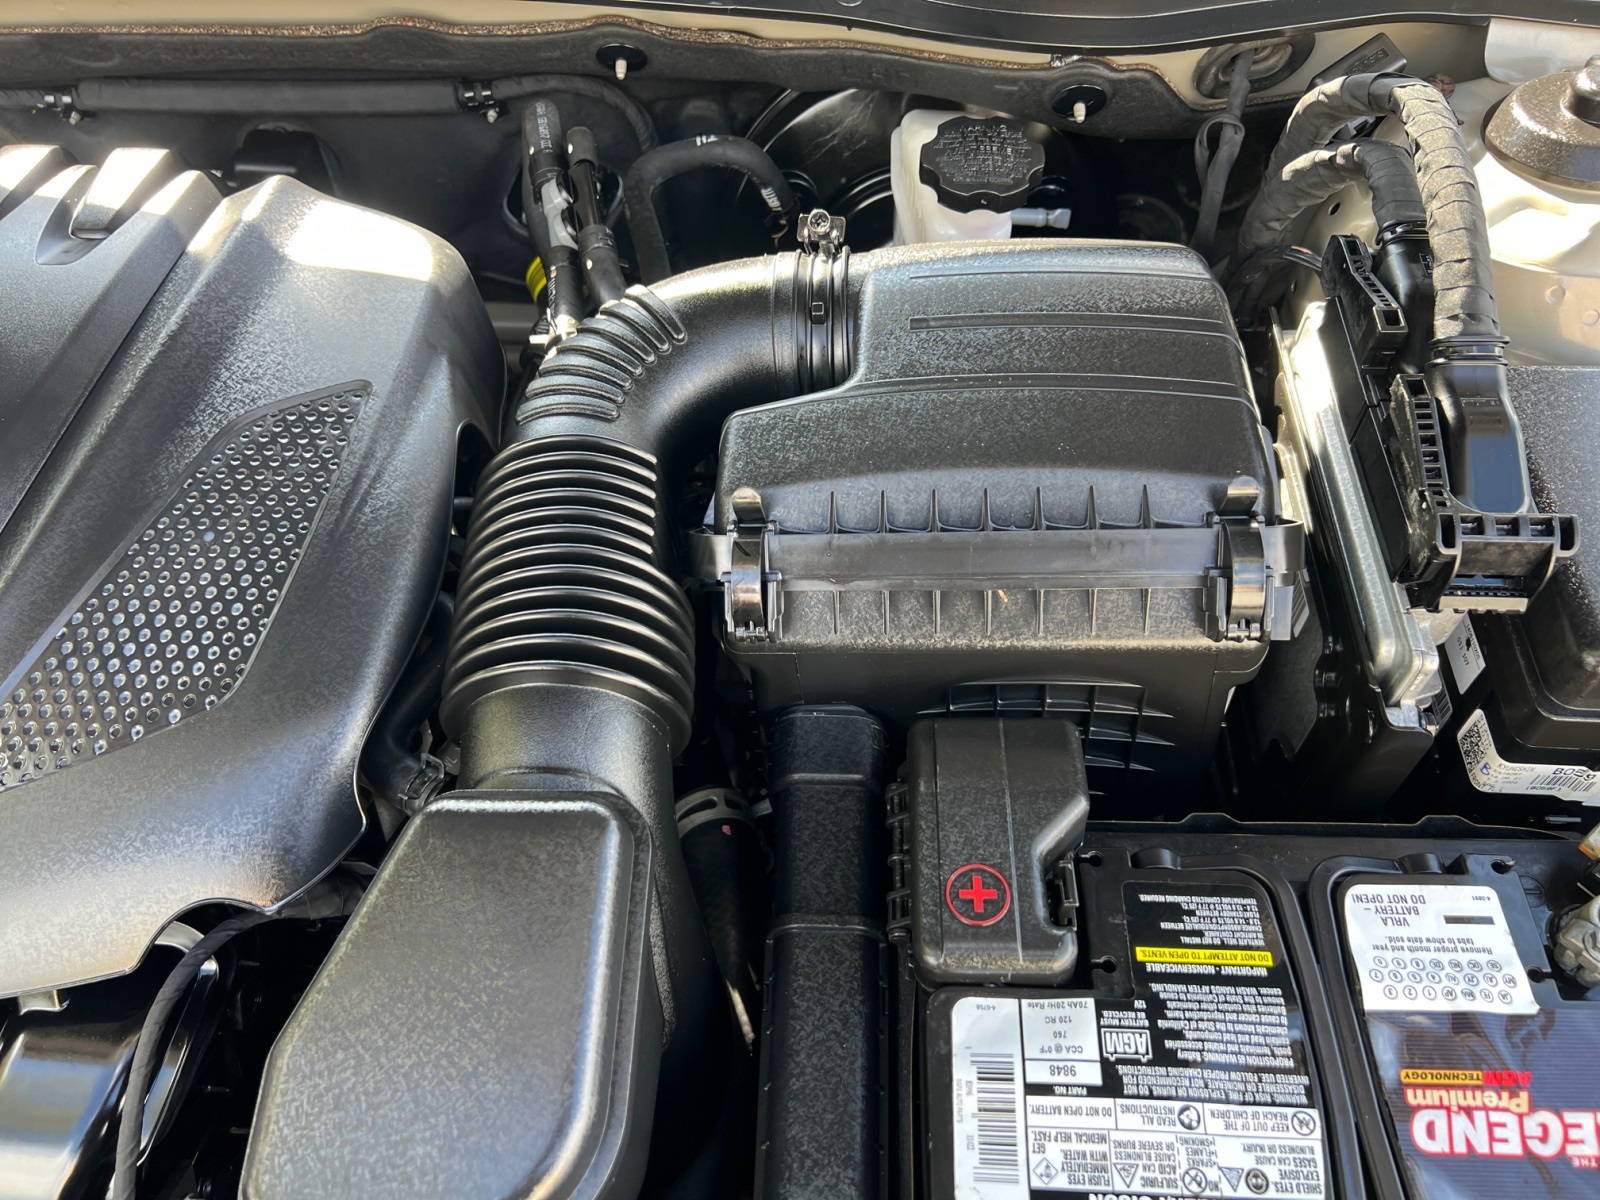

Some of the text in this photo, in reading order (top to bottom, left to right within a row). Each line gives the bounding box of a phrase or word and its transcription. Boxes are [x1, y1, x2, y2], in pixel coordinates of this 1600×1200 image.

[1351, 893, 1426, 904] DO NOT OPEN!
[1374, 905, 1420, 916] BATTERY
[1380, 916, 1410, 926] VRLA
[1384, 936, 1404, 944] sold.
[1406, 936, 1424, 944] date
[1426, 937, 1445, 945] show
[1456, 938, 1474, 946] tabs
[1391, 944, 1404, 952] and
[1406, 945, 1431, 953] month
[1434, 944, 1458, 954] proper
[1460, 946, 1492, 954] Remove
[1140, 950, 1269, 962] DO NOT ATTEMPT TO OPEN VENTS.
[1146, 962, 1268, 977] IMPORTANT NONSERVICEABLE
[1028, 1000, 1088, 1010] 70Ah 20Hr Rate
[1044, 1016, 1056, 1024] RC
[1102, 1010, 1146, 1020] BE RECYCLED.
[1100, 1017, 1149, 1027] BATTERY MUST
[1053, 1030, 1067, 1038] 760
[1054, 1044, 1062, 1053] @
[1064, 1044, 1083, 1054] CCA
[1105, 1032, 1147, 1054] AGM
[1177, 1048, 1201, 1062] Battery
[1237, 1054, 1246, 1066] 65
[1246, 1055, 1294, 1068] PROPOSITION
[1049, 1064, 1076, 1077] 9848
[1116, 1064, 1310, 1086] INVERTED USE. FOLLOW PROPER CHARGING INSTRUCTIONS.
[1122, 1074, 1137, 1084] FOR
[1138, 1075, 1190, 1087] RECOMMENDED
[1190, 1078, 1204, 1088] NOT
[1402, 1070, 1532, 1086] AGM TECHNOLOGY
[1053, 1085, 1087, 1096] PART NO.
[1123, 1084, 1138, 1096] NOT
[1138, 1084, 1150, 1096] DO
[1176, 1086, 1188, 1098] OR
[1188, 1086, 1225, 1100] EXPLOSION
[1246, 1082, 1258, 1092] OR
[1258, 1082, 1305, 1094] DISASSEMBLE
[1244, 1092, 1254, 1103] OF
[1254, 1092, 1272, 1105] RISK
[1272, 1093, 1308, 1106] WARNING:
[1406, 1088, 1530, 1114] Premium
[1029, 1104, 1112, 1117] DO NOT OPEN BATTERY.
[1117, 1103, 1175, 1115] INSTRUCTIONS.
[1208, 1108, 1288, 1121] REACH OF CHILDREN.
[1140, 1115, 1176, 1126] READ ALL
[1222, 1120, 1290, 1132] KEEP OUT OF THE
[1031, 1130, 1107, 1144] MEDICAL HELP FAST.
[1412, 1108, 1600, 1158] EGEND
[1032, 1142, 1046, 1154] GET
[1110, 1139, 1174, 1151] OR SEVERE BURNS.
[1240, 1142, 1315, 1155] BLINDNESS OR INJURY.
[1060, 1148, 1108, 1162] WITH WATER.
[1114, 1150, 1176, 1162] CAUSE BLINDNESS
[1061, 1160, 1109, 1174] IMMEDIATELY
[1254, 1155, 1317, 1168] GASES CAN CAUSE
[1570, 1156, 1597, 1168] THE
[1142, 1162, 1176, 1176] ACID CAN
[1278, 1168, 1320, 1182] EXPLOSIVE
[1068, 1173, 1110, 1186] FLUSH EYES
[1140, 1176, 1178, 1189] SULFURIC
[1208, 1180, 1220, 1192] NO
[1271, 1181, 1322, 1194] SHIELD EYES.
